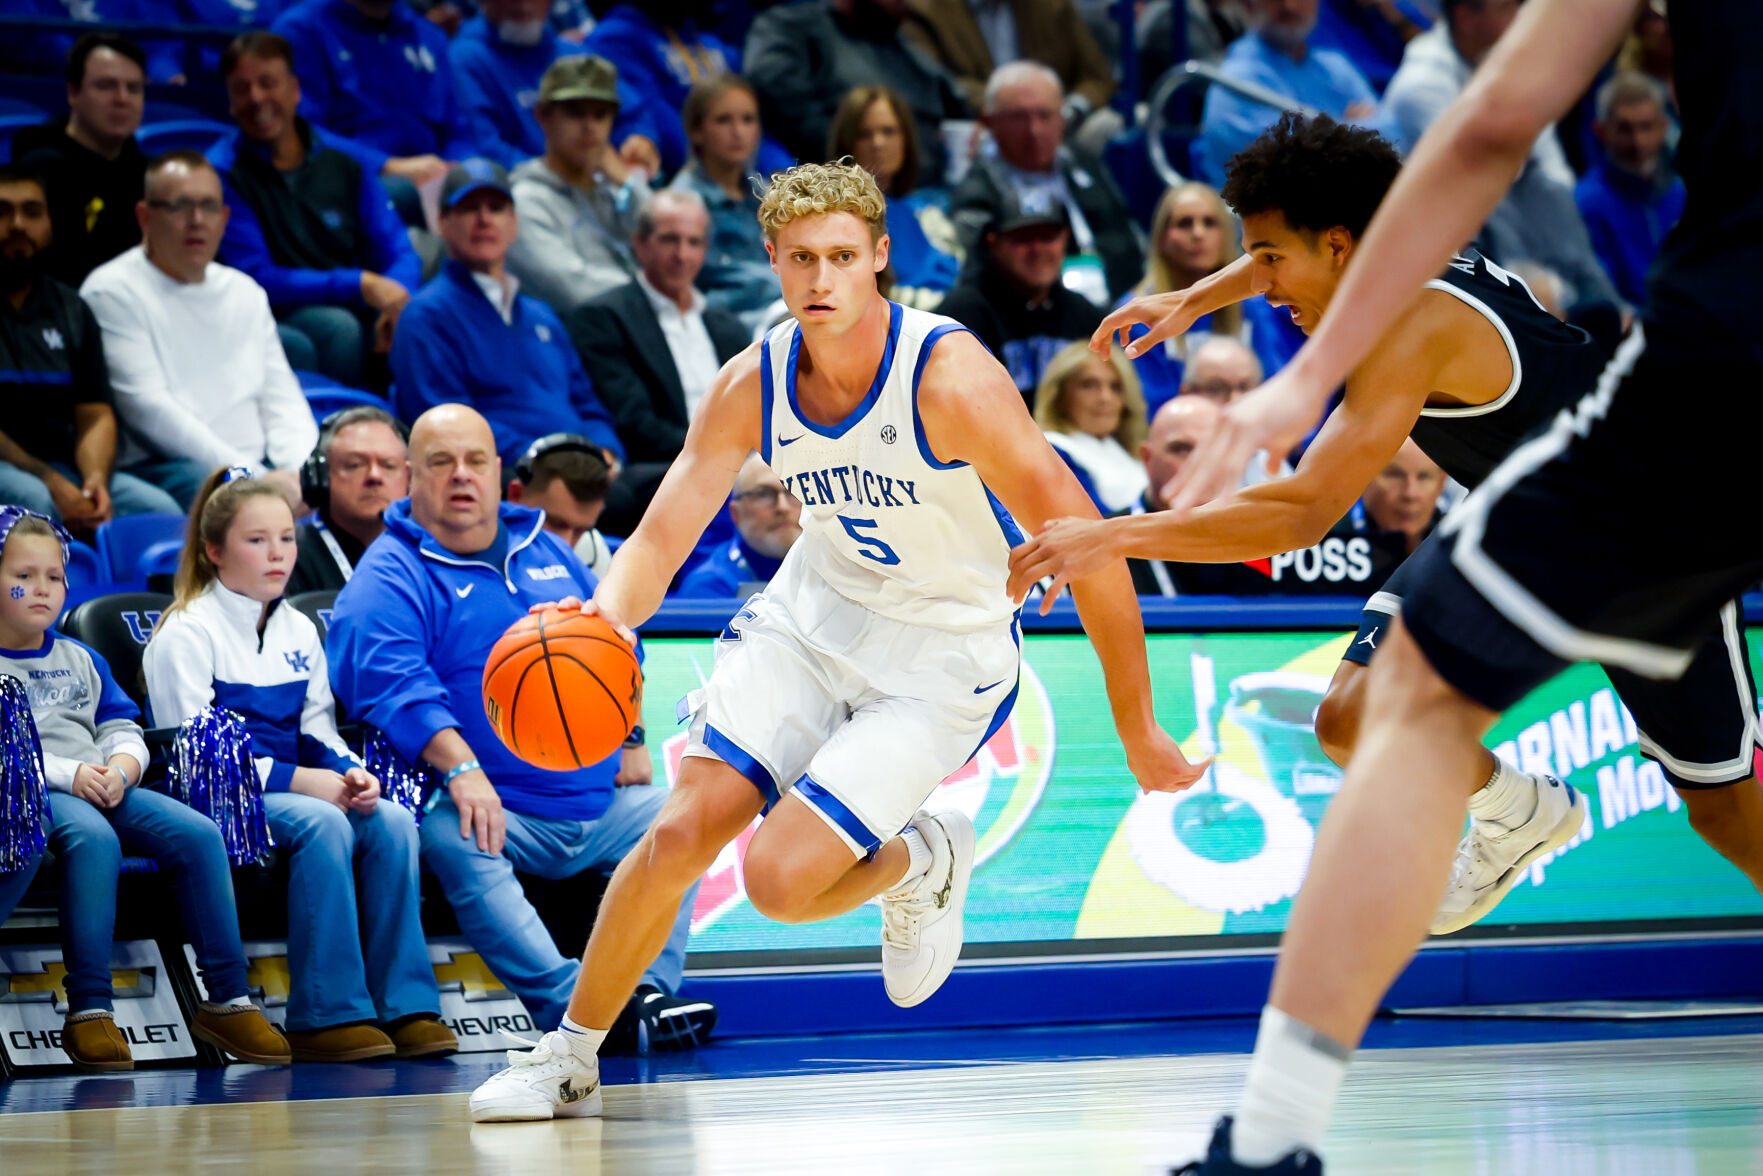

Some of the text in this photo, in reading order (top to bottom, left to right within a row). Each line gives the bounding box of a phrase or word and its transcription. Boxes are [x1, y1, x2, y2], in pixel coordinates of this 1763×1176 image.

[881, 426, 896, 443] SEC
[837, 514, 901, 565] 5
[1271, 537, 1372, 582] POSS
[284, 650, 310, 672] UK
[9, 1024, 178, 1049] CHELET
[441, 1014, 532, 1036] HEVRO
